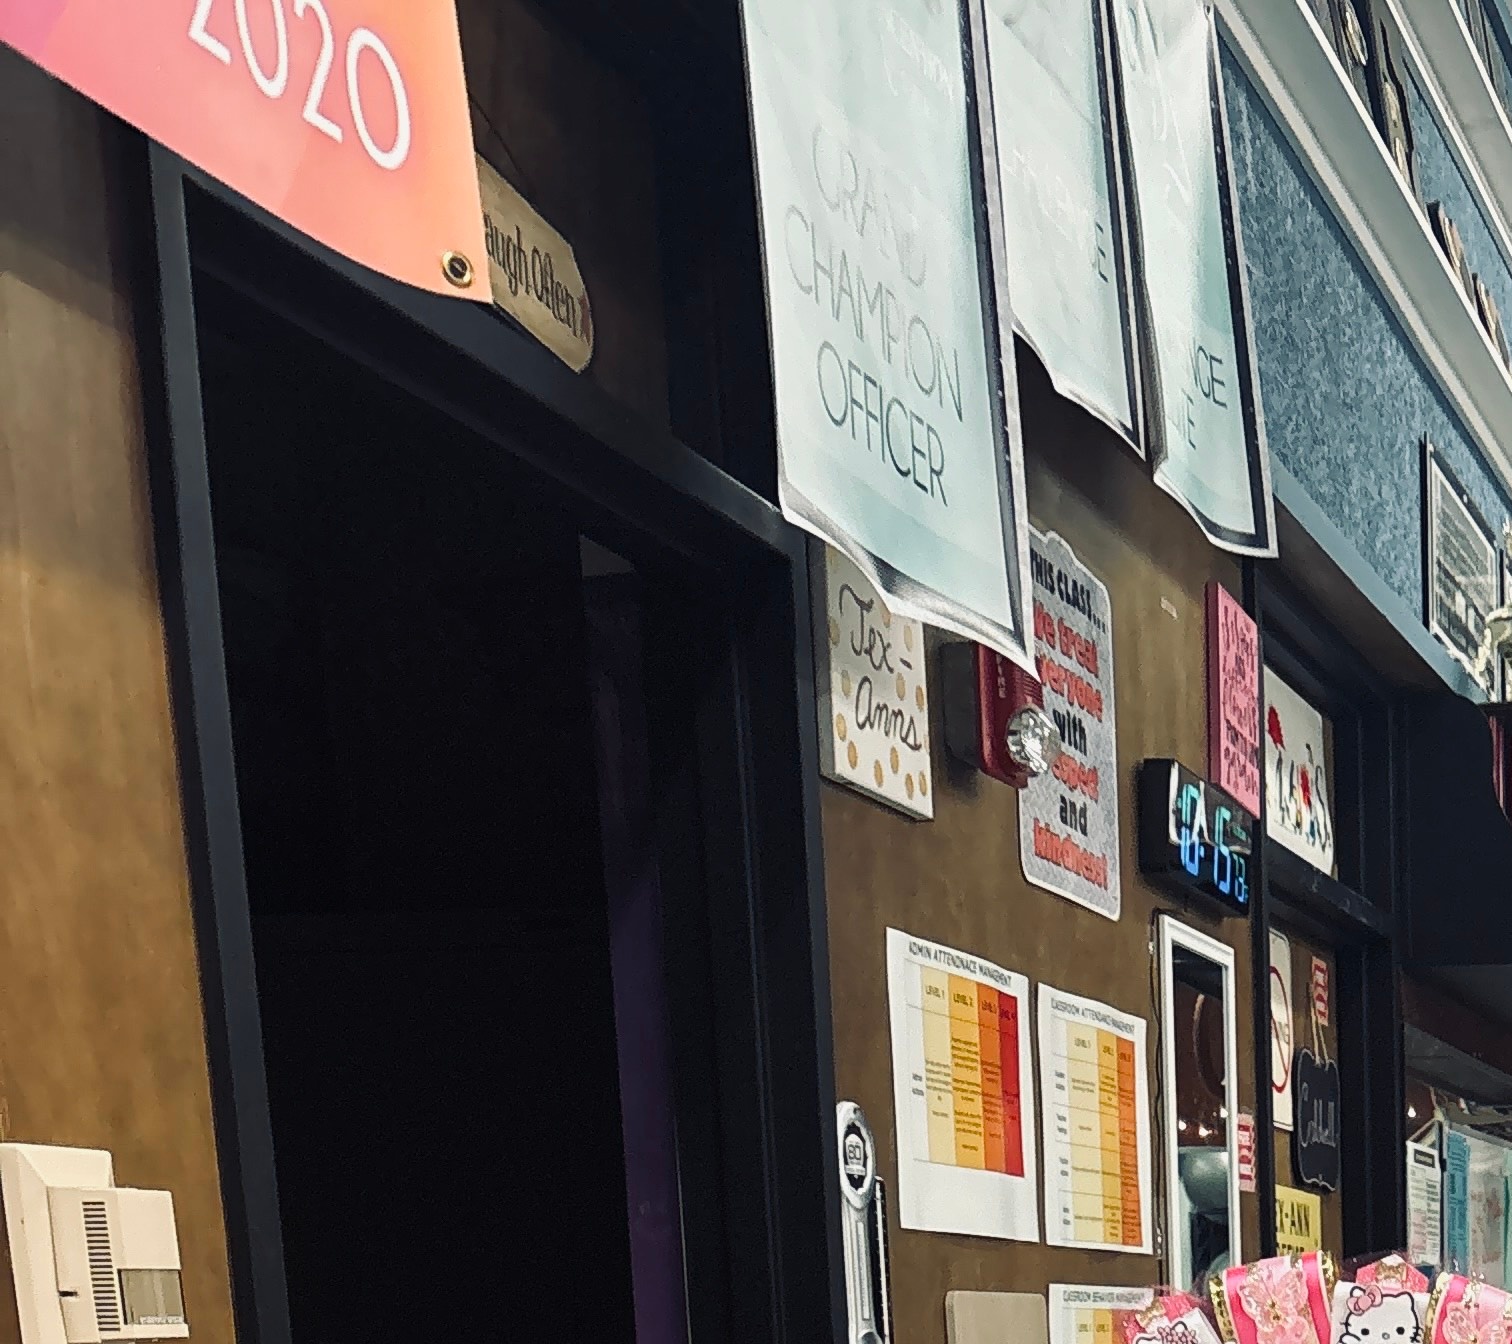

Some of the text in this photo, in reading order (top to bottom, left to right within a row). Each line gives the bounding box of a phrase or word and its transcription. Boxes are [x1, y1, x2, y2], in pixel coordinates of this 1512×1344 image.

[484, 211, 530, 296] augh
[785, 204, 964, 423] CHAMPION
[817, 339, 949, 508] OFFICER
[1040, 655, 1103, 722] veryone
[1053, 708, 1088, 757] with
[1059, 793, 1088, 837] and
[909, 941, 932, 963] ADMIN
